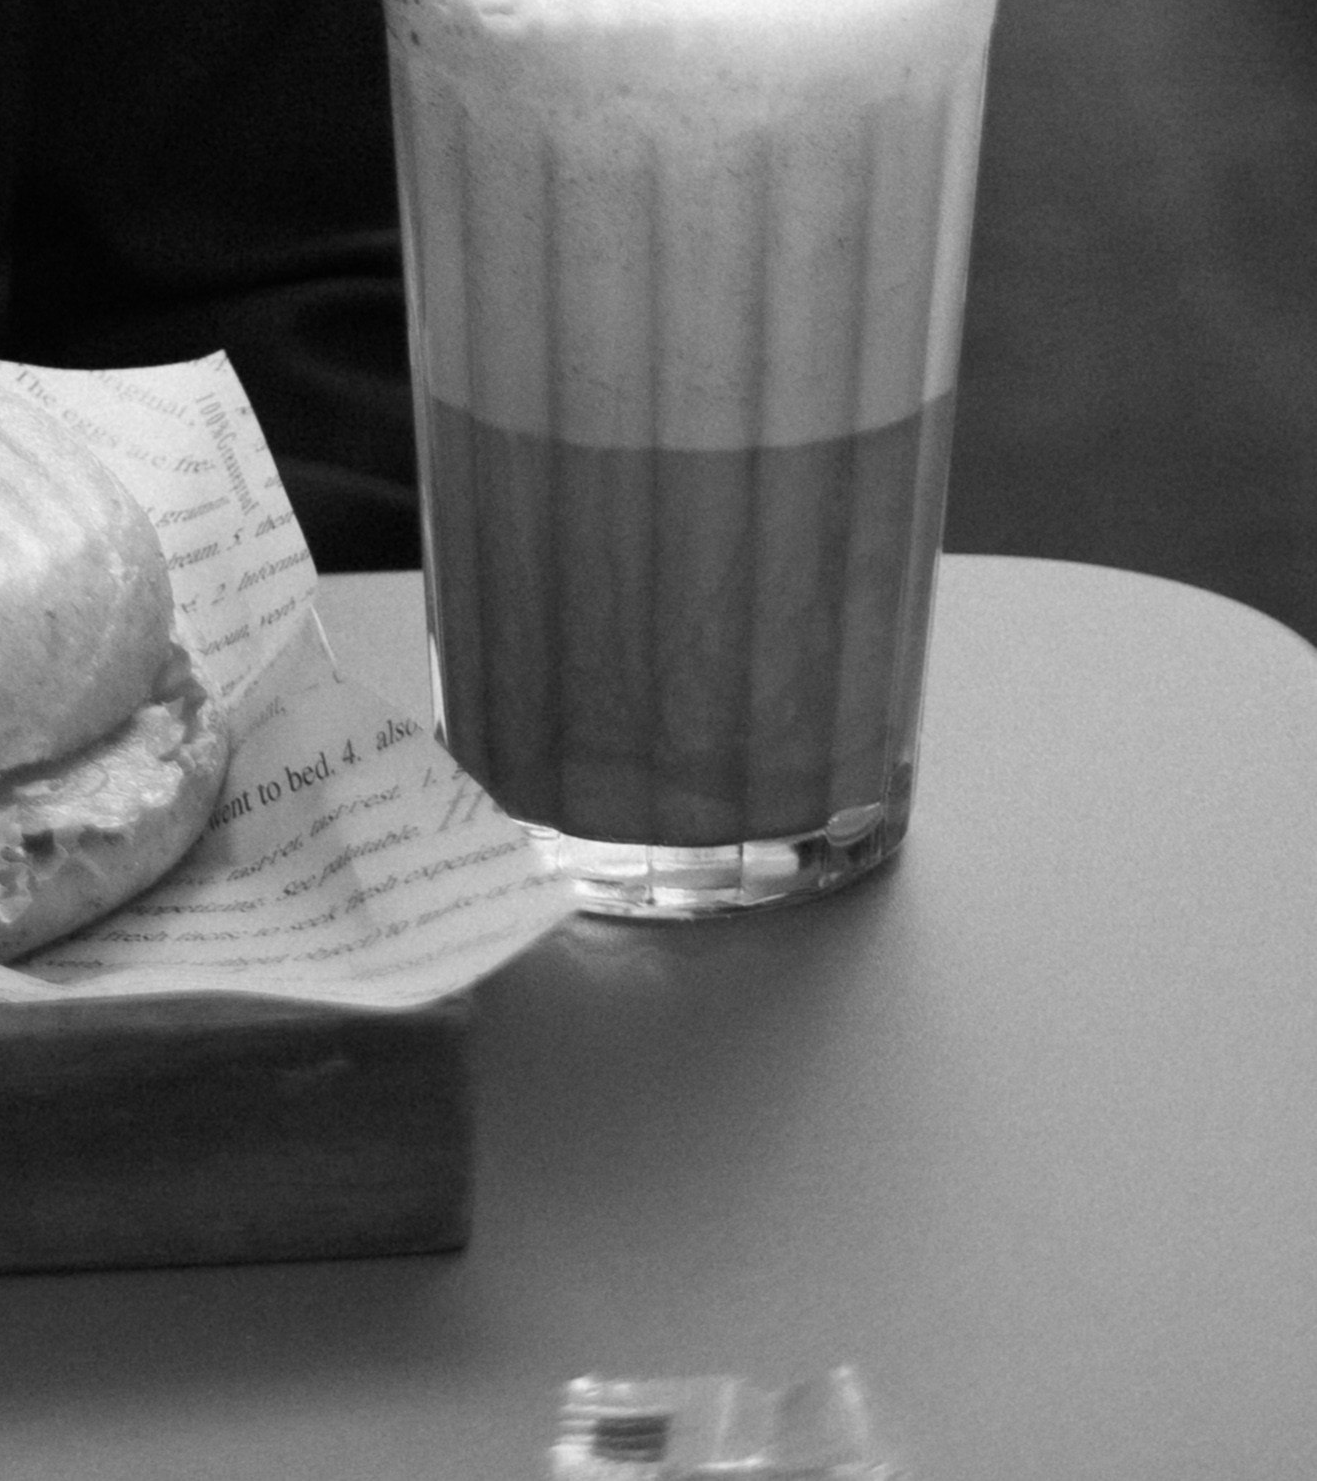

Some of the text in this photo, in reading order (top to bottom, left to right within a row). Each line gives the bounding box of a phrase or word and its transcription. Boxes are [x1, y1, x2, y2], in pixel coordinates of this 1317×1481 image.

[257, 779, 282, 806] to
[284, 751, 336, 793] bed.
[342, 737, 362, 765] 4.
